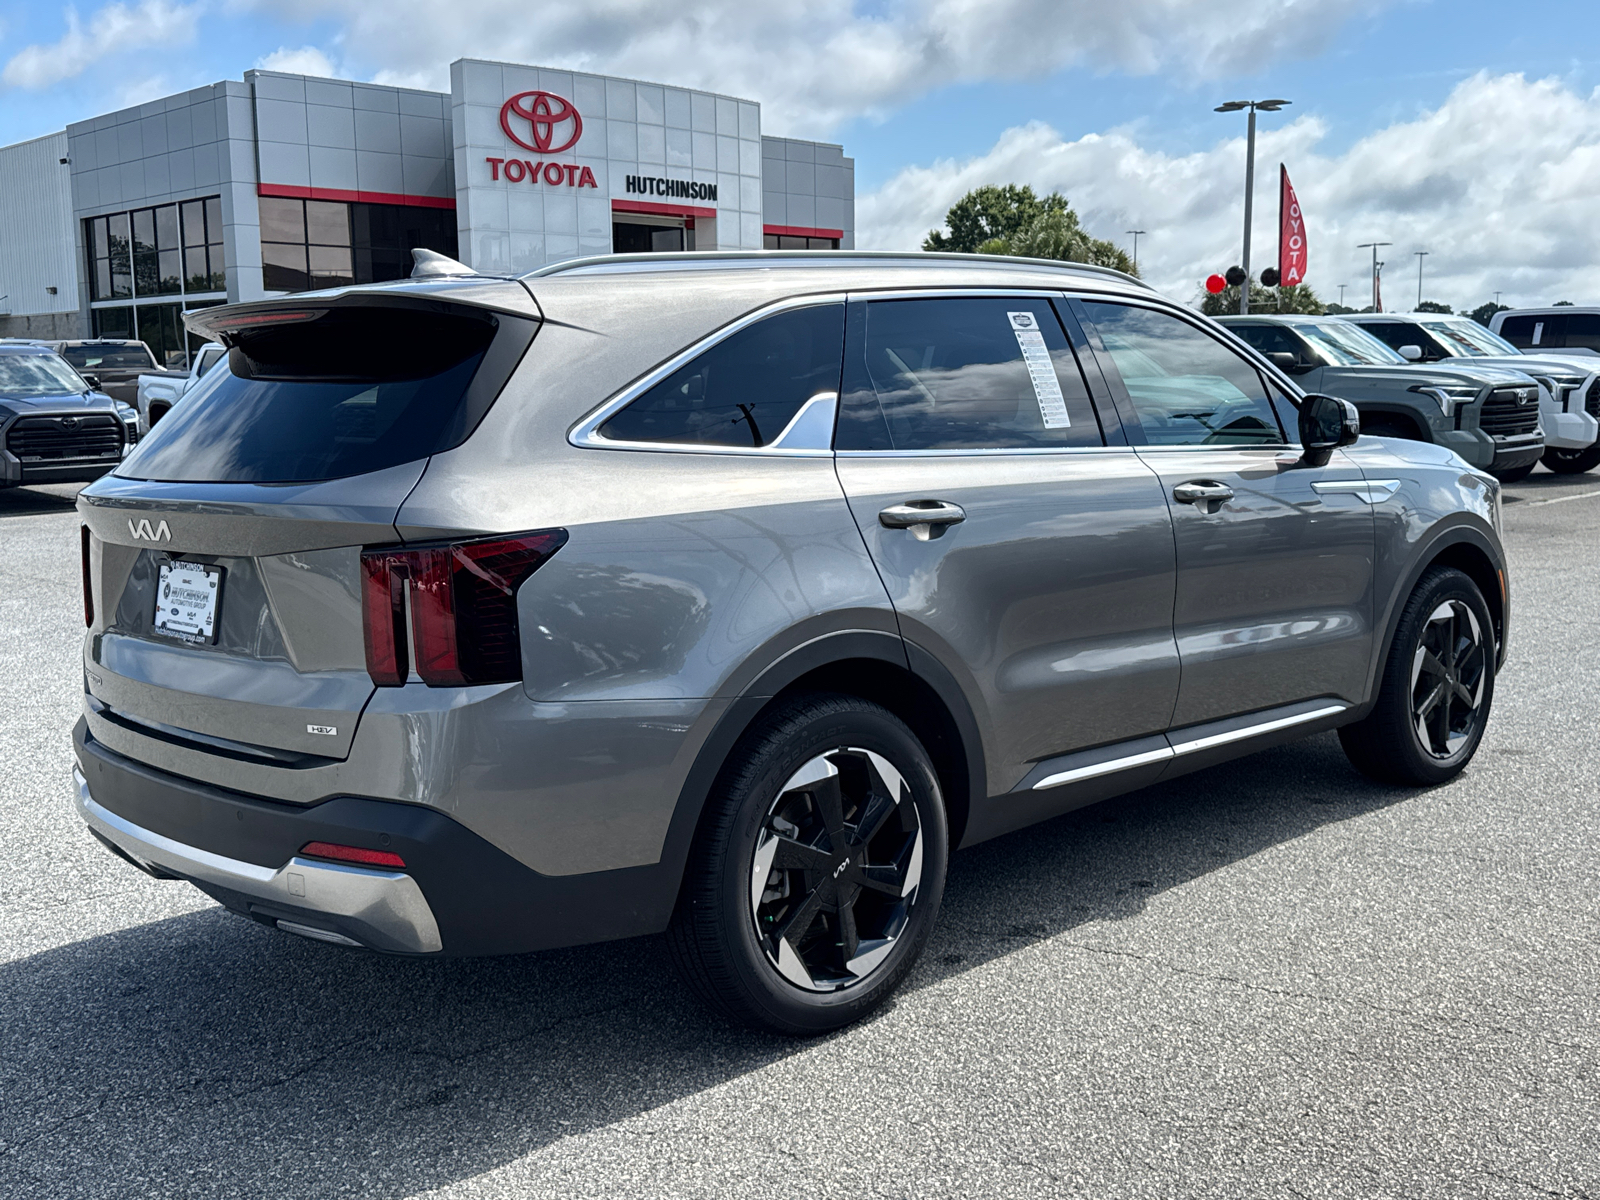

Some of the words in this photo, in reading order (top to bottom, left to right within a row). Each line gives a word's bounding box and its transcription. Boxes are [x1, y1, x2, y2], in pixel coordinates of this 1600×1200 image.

[486, 157, 598, 188] TOYOTA
[626, 174, 718, 202] HUTCHINSON
[128, 518, 172, 542] KIA
[312, 726, 333, 734] HEV
